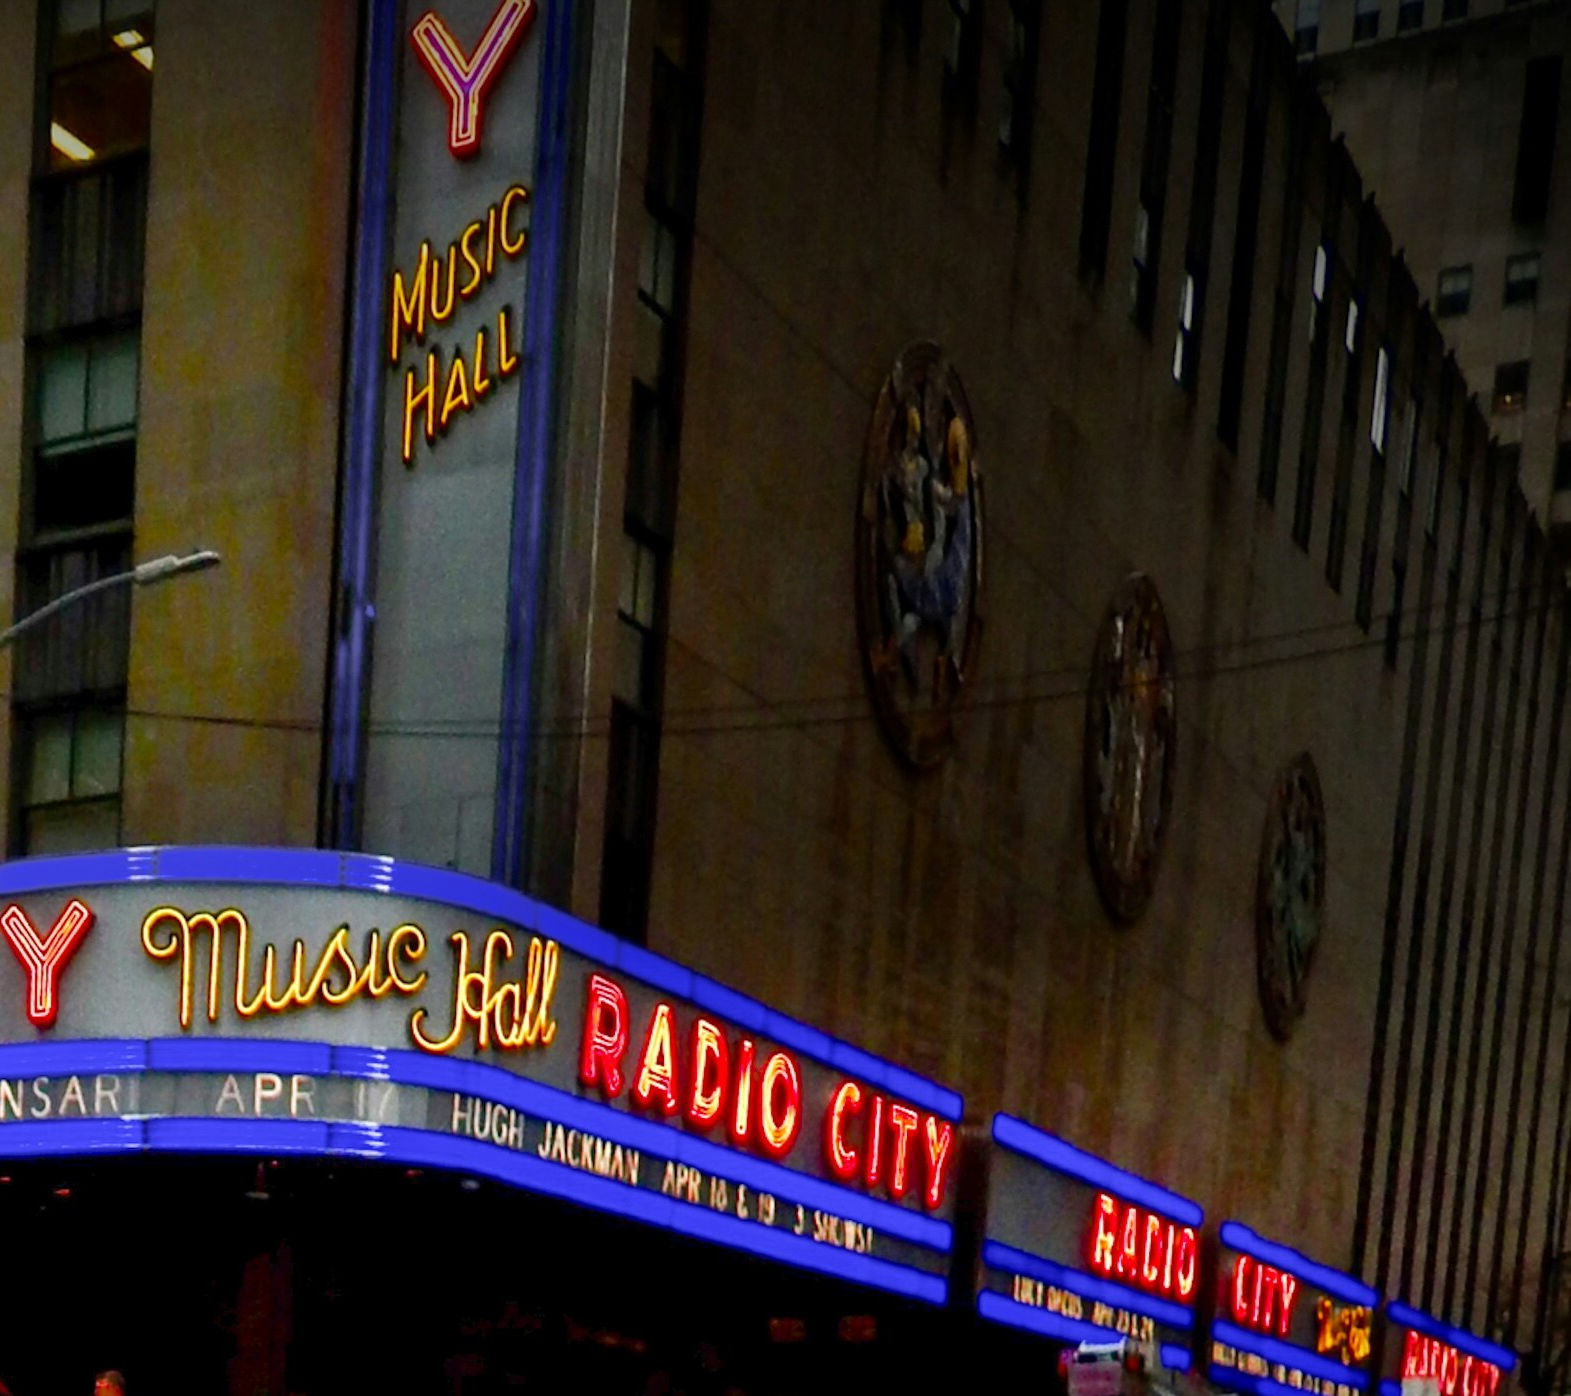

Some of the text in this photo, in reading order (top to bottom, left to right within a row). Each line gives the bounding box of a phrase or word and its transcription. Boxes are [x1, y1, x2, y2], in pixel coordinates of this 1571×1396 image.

[390, 185, 528, 364] MUSIC
[402, 311, 517, 462] HALL
[142, 907, 428, 1029] Music
[412, 929, 561, 1052] Hall
[582, 972, 802, 1158] RADIO
[829, 1080, 954, 1208] CITY
[215, 1072, 315, 1117] APR
[452, 1092, 525, 1149] HUGH
[538, 1120, 641, 1187] JACKMAN
[662, 1160, 702, 1204] APR
[758, 1191, 776, 1226] 19
[793, 1203, 805, 1236] 3
[1091, 1193, 1199, 1299] RADIO
[1232, 1254, 1298, 1337] CITY
